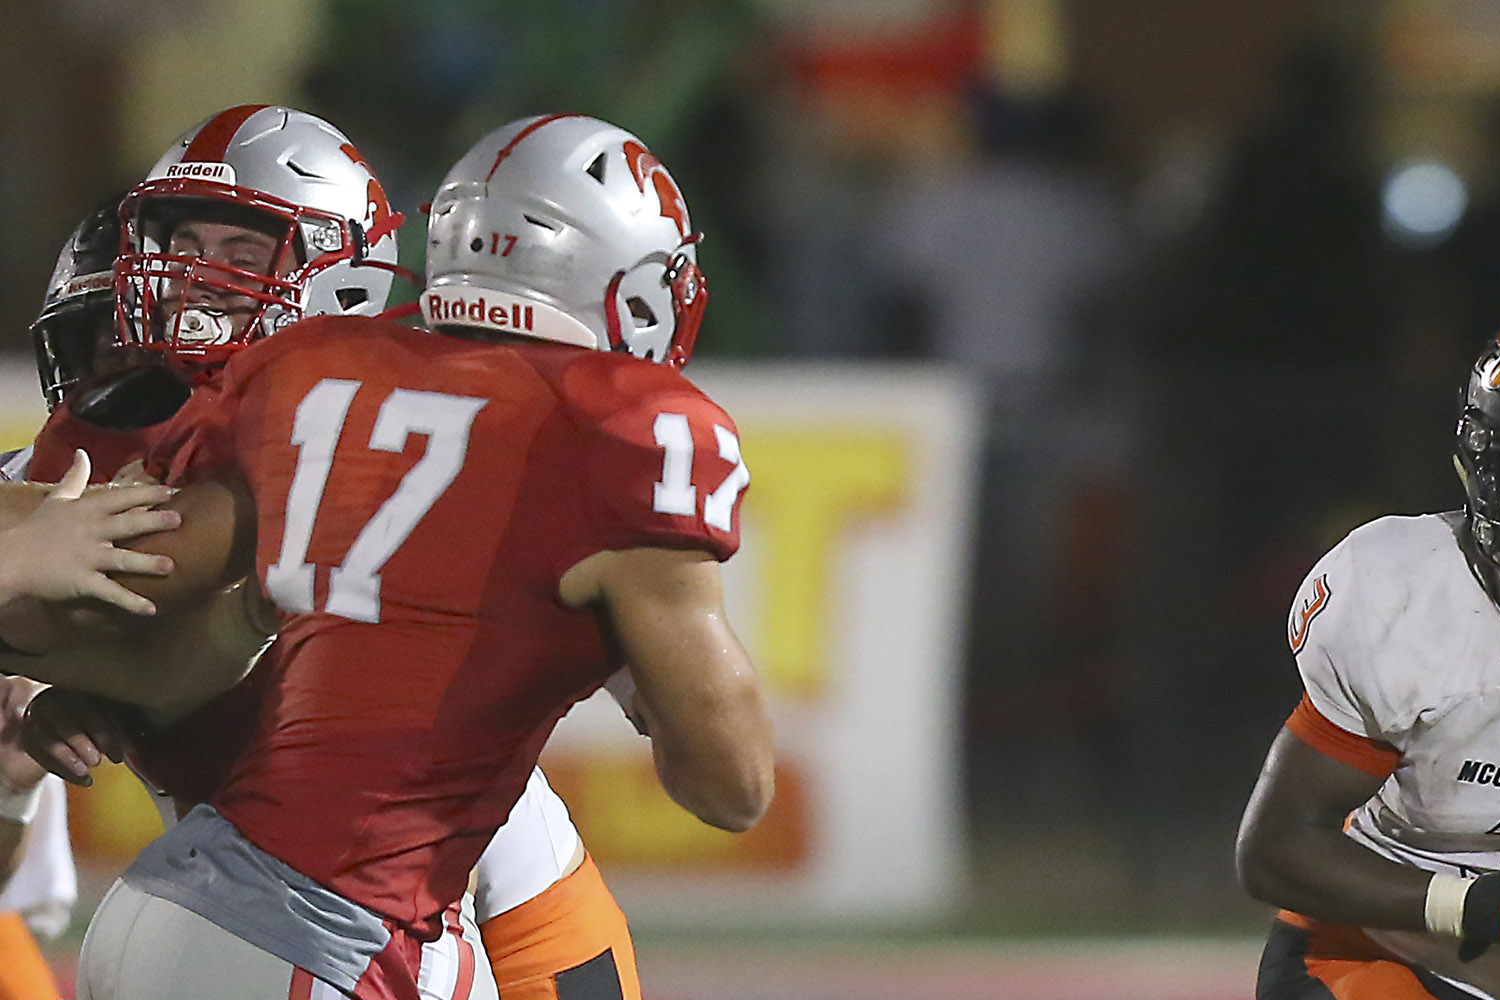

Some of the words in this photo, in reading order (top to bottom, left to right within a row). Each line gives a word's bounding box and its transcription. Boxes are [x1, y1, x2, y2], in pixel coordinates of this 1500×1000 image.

[166, 164, 225, 178] Riddell
[490, 232, 519, 257] 17
[429, 294, 535, 332] Riddell
[652, 412, 751, 533] 17
[265, 377, 490, 624] 17
